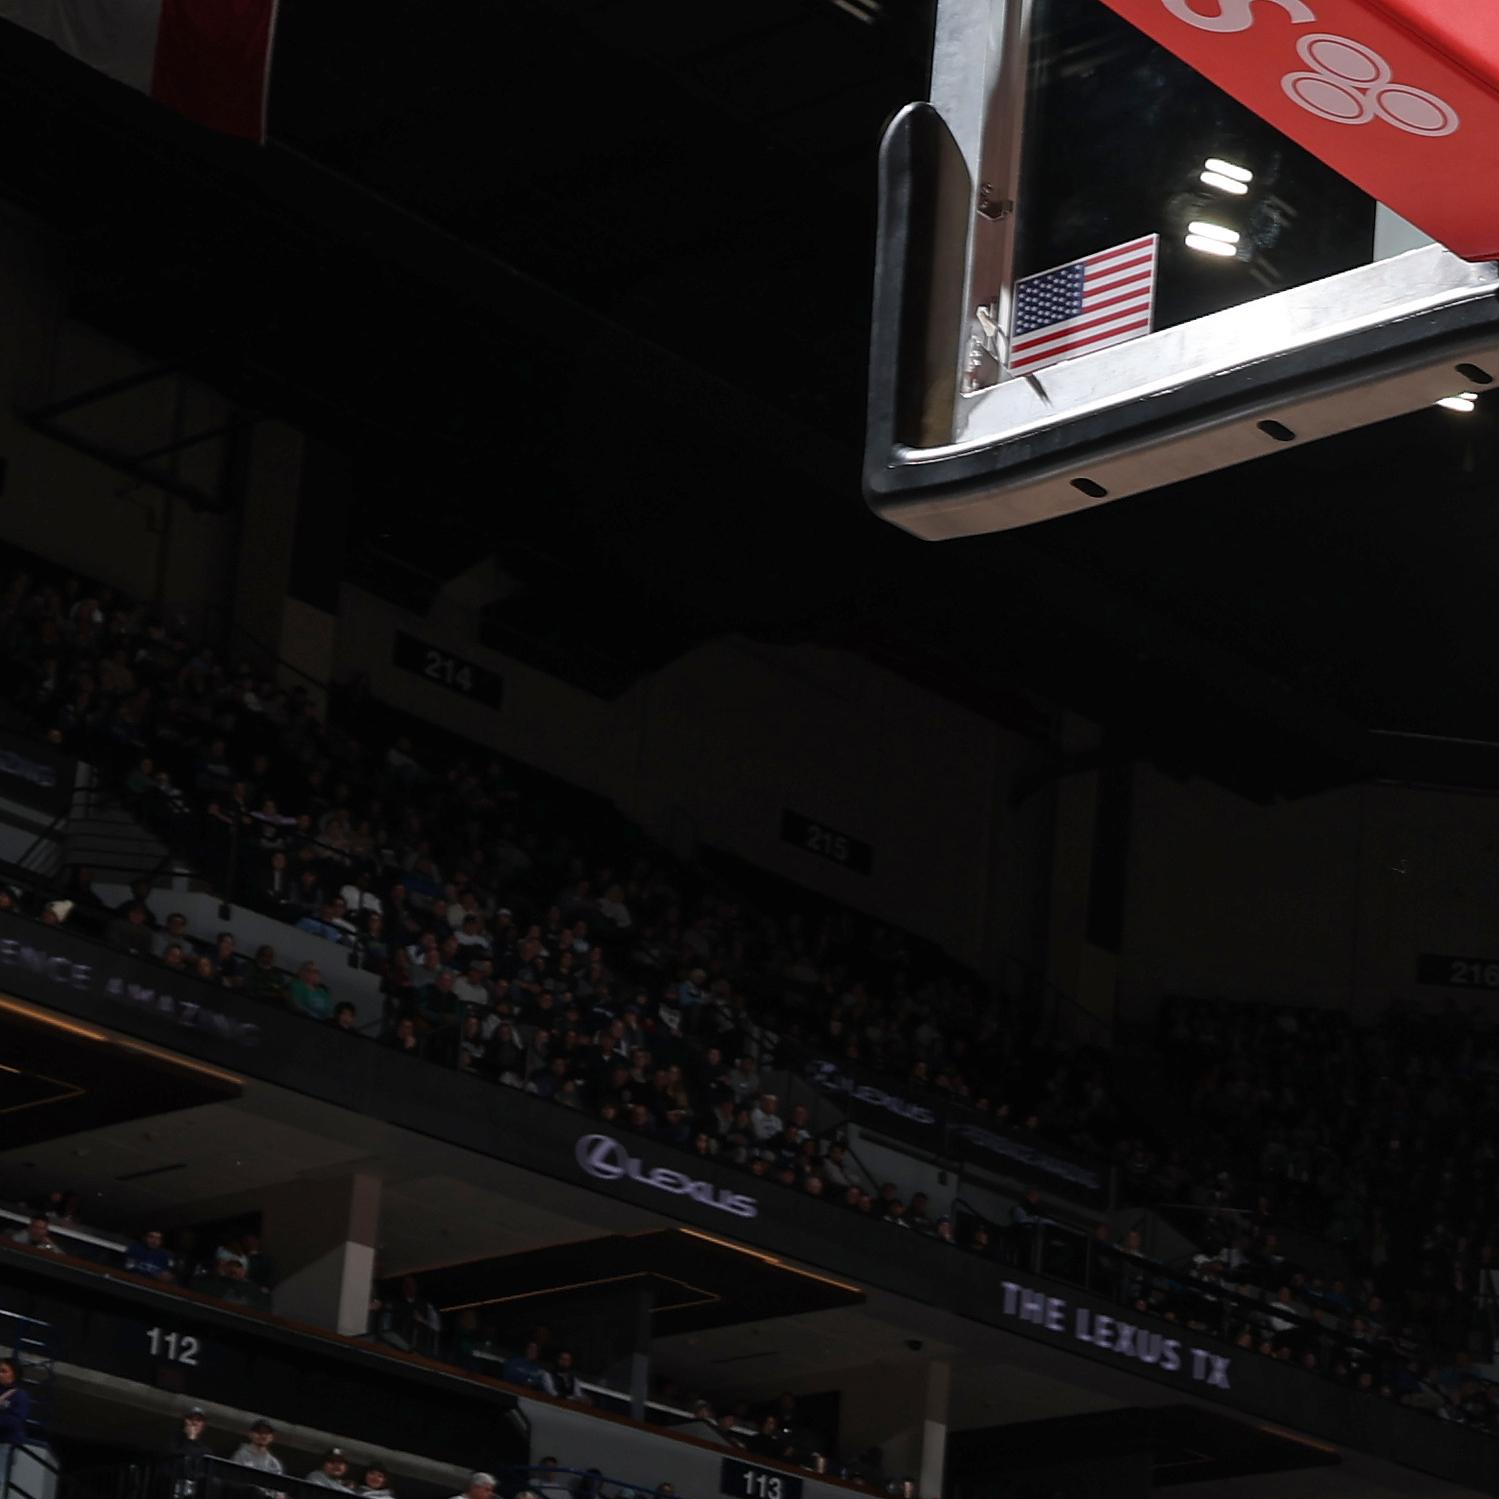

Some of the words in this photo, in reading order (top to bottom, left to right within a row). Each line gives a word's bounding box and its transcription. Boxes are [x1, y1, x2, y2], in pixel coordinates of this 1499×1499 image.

[422, 648, 474, 692] 214
[805, 822, 851, 863] 215
[630, 1156, 760, 1219] LEXUS
[145, 1326, 201, 1367] 112
[1001, 1280, 1067, 1333] THE
[1074, 1307, 1182, 1372] LEXUS
[1189, 1347, 1232, 1390] TX
